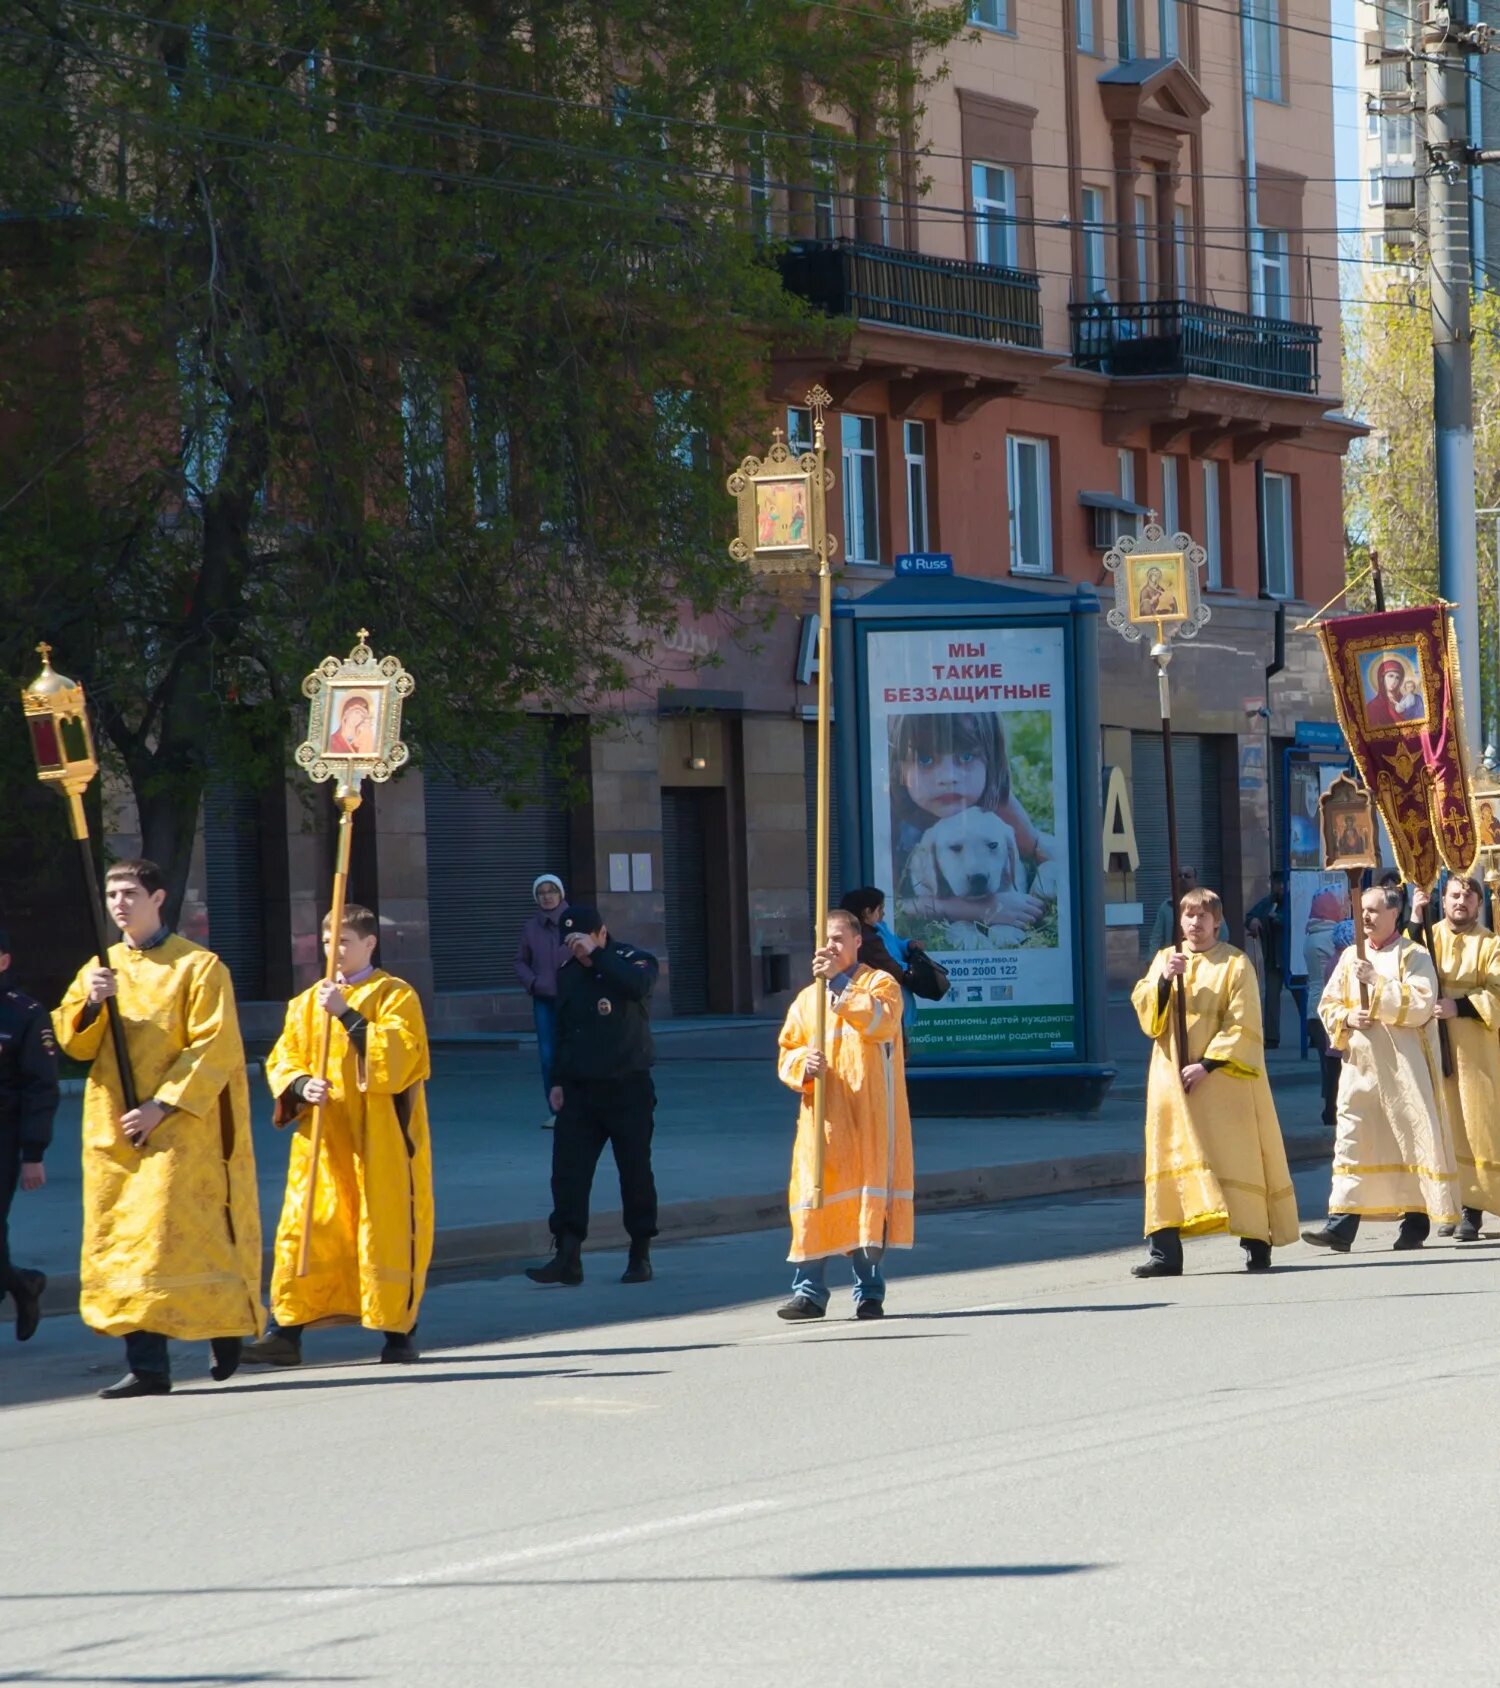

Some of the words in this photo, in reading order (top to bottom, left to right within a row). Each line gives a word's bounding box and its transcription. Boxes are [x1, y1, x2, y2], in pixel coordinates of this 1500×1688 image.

[915, 558, 948, 569] Russ
[948, 642, 985, 658] МЫ
[932, 663, 1003, 680] ТАКИЕ
[884, 683, 1051, 703] БЕЗЗАЩИТНЫЕ
[950, 967, 969, 977] 800
[973, 966, 997, 976] 2000
[1000, 965, 1017, 975] 122
[990, 1015, 1018, 1026] детей
[1009, 1031, 1061, 1042] родителей
